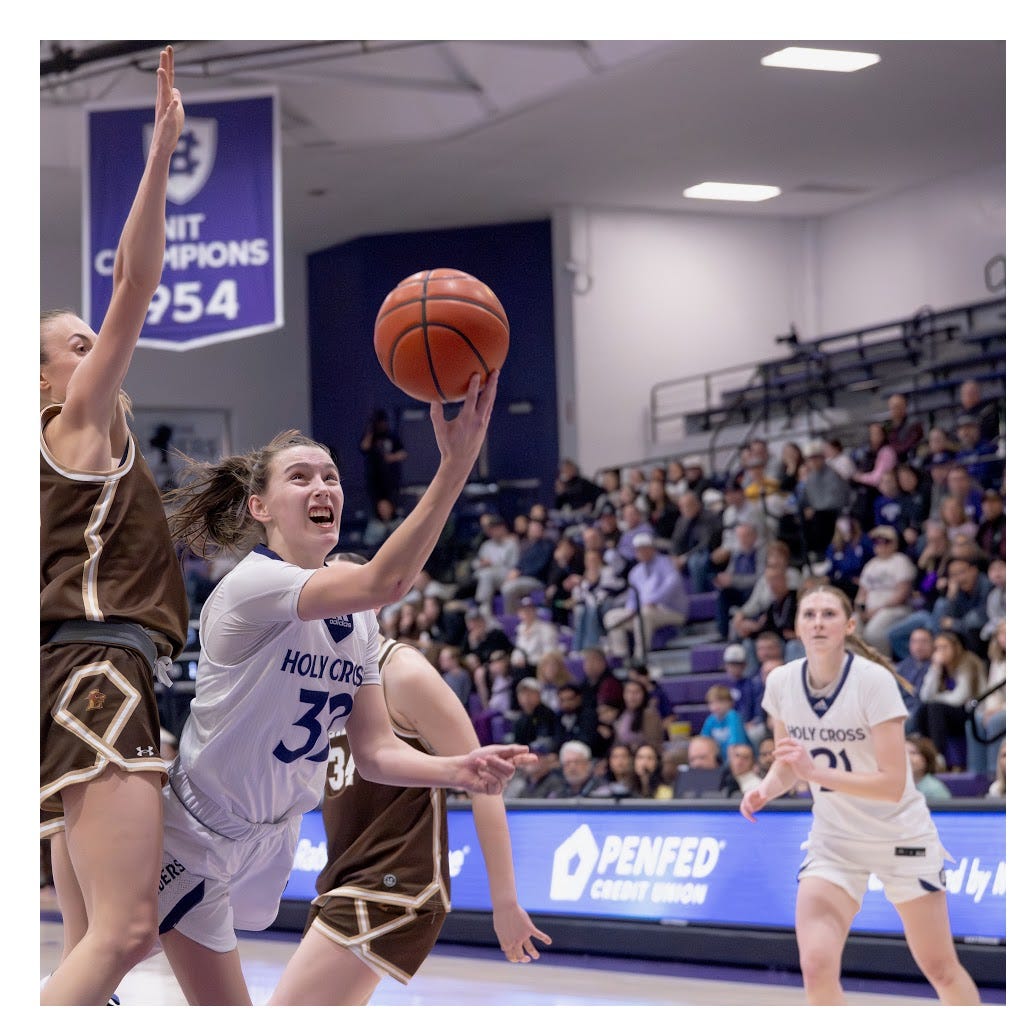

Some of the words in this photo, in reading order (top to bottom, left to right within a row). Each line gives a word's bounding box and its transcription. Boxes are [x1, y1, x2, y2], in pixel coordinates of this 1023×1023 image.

[94, 238, 269, 276] CMPIONS
[146, 279, 239, 325] 954
[280, 649, 329, 679] HOLY
[272, 688, 354, 764] 32
[788, 726, 816, 741] HOLY
[819, 727, 866, 742] CROSS
[597, 835, 720, 879] PENFED
